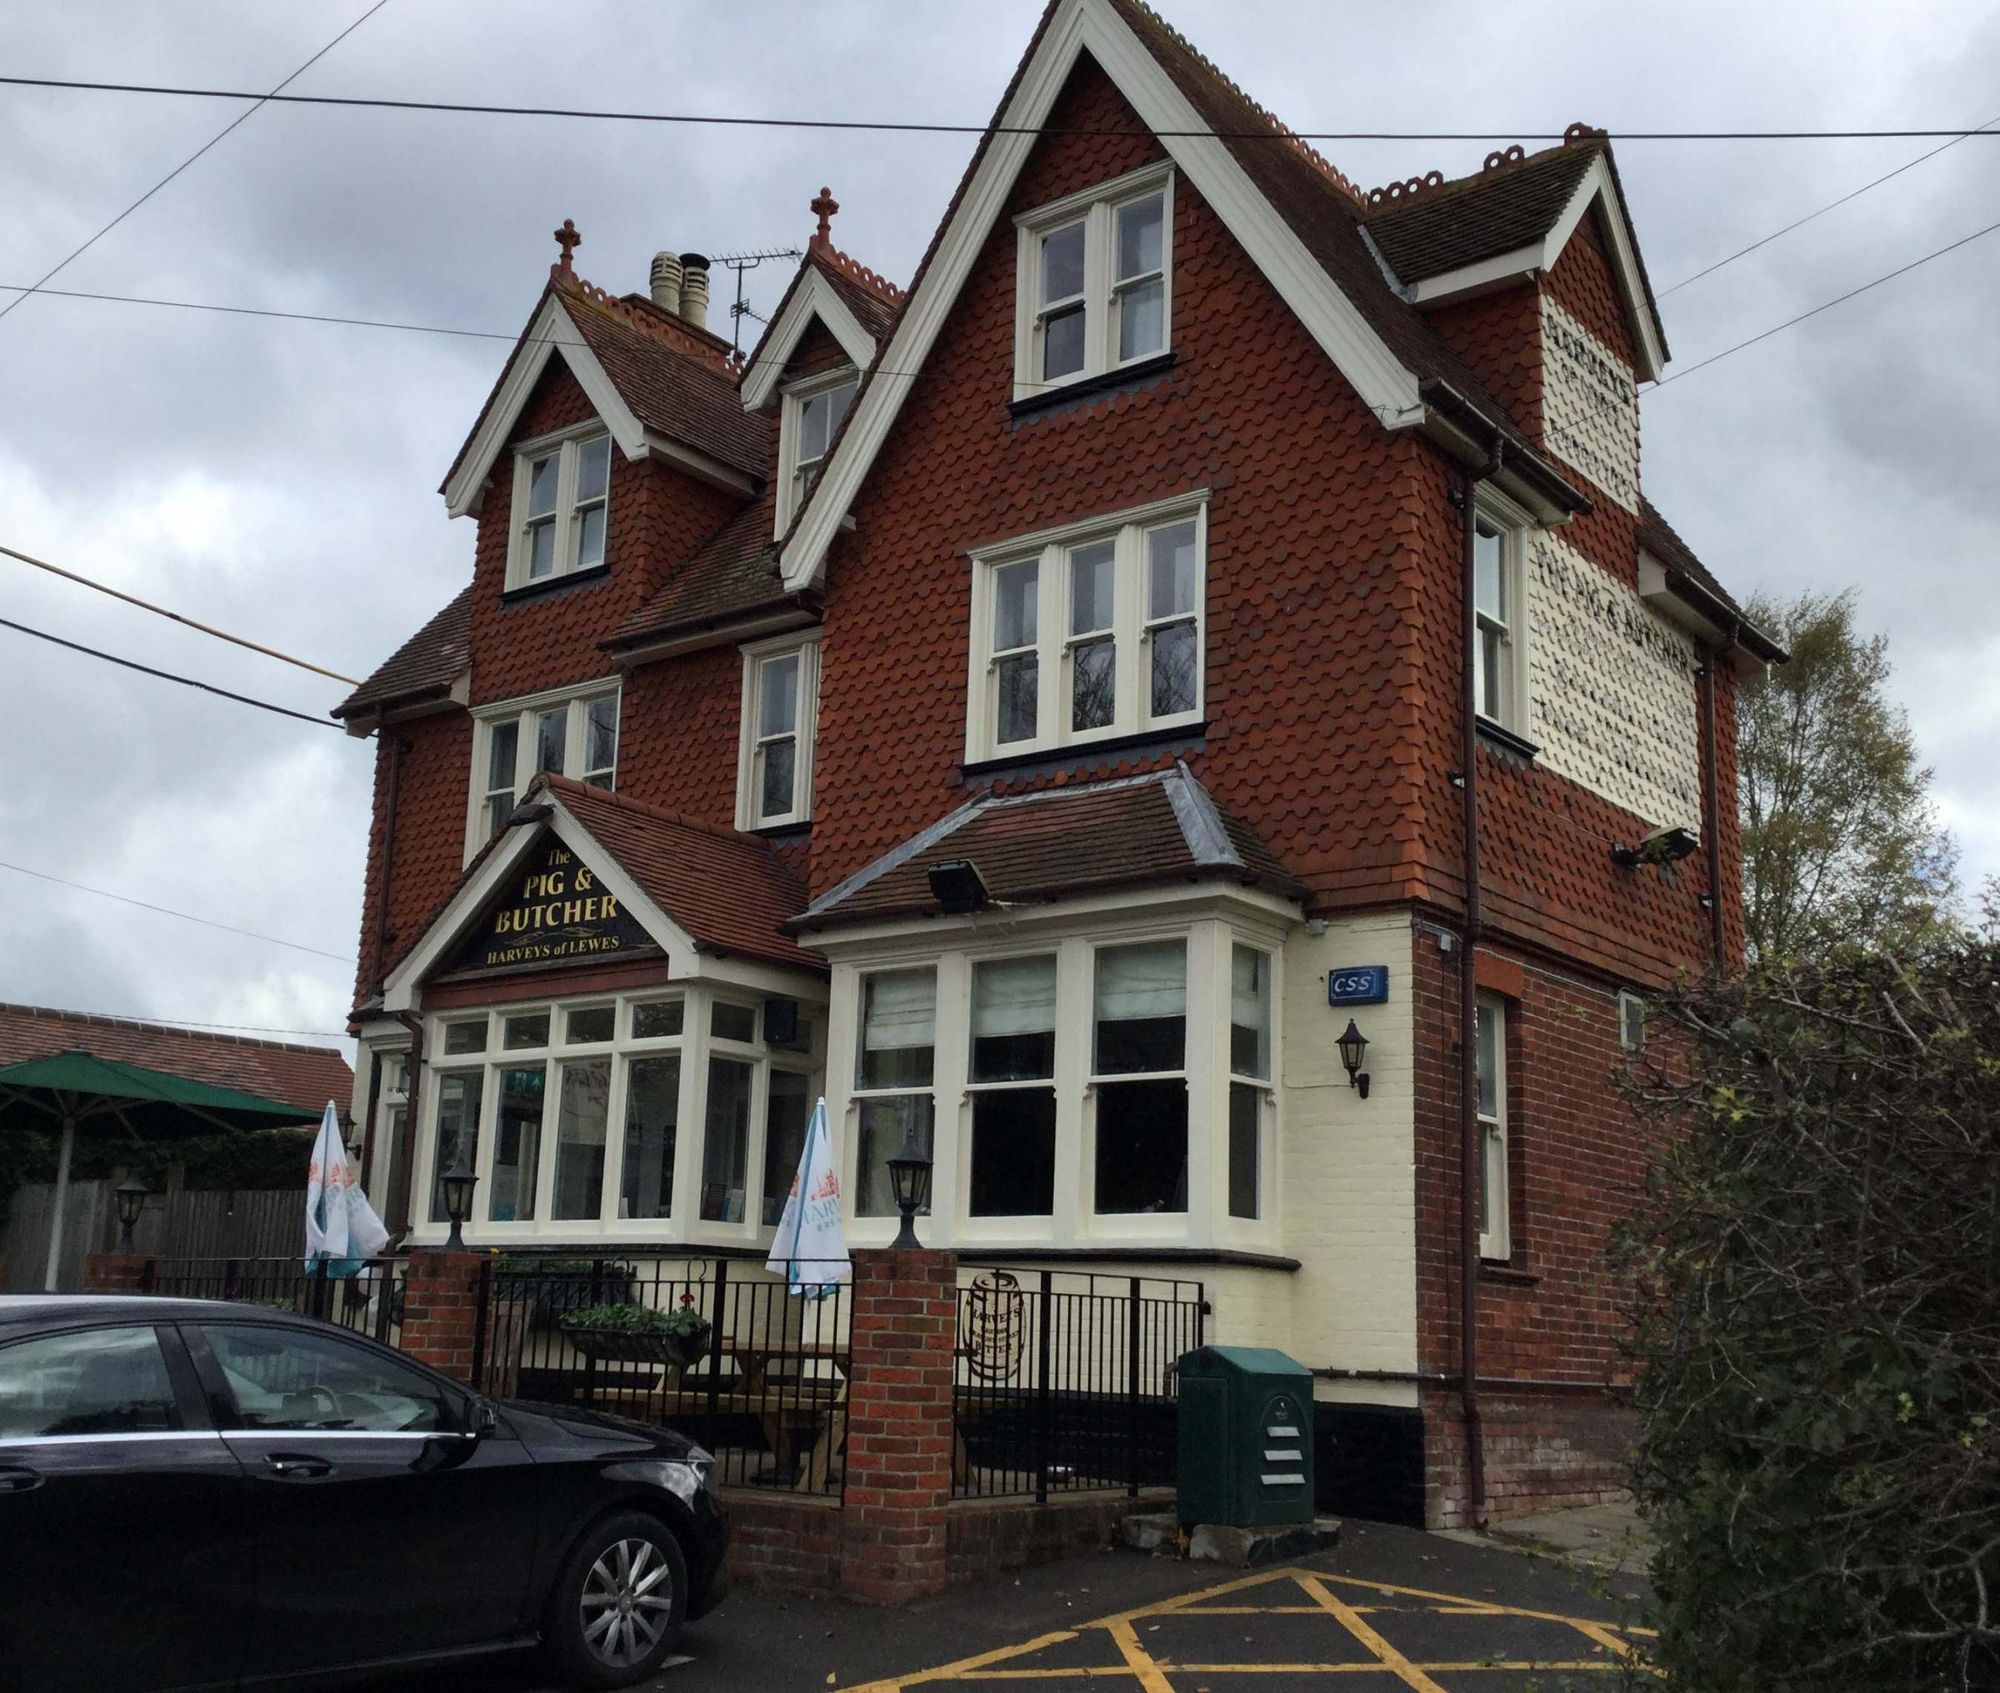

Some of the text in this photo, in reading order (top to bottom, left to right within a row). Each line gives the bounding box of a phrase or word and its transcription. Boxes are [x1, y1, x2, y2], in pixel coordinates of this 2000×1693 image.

[1623, 610, 1688, 677] BUTCHER
[548, 849, 571, 866] The
[523, 867, 593, 899] PIG &
[495, 895, 618, 933] BUTCHER
[487, 936, 620, 964] HARVEYS of LEWES
[1334, 976, 1371, 992] CSS
